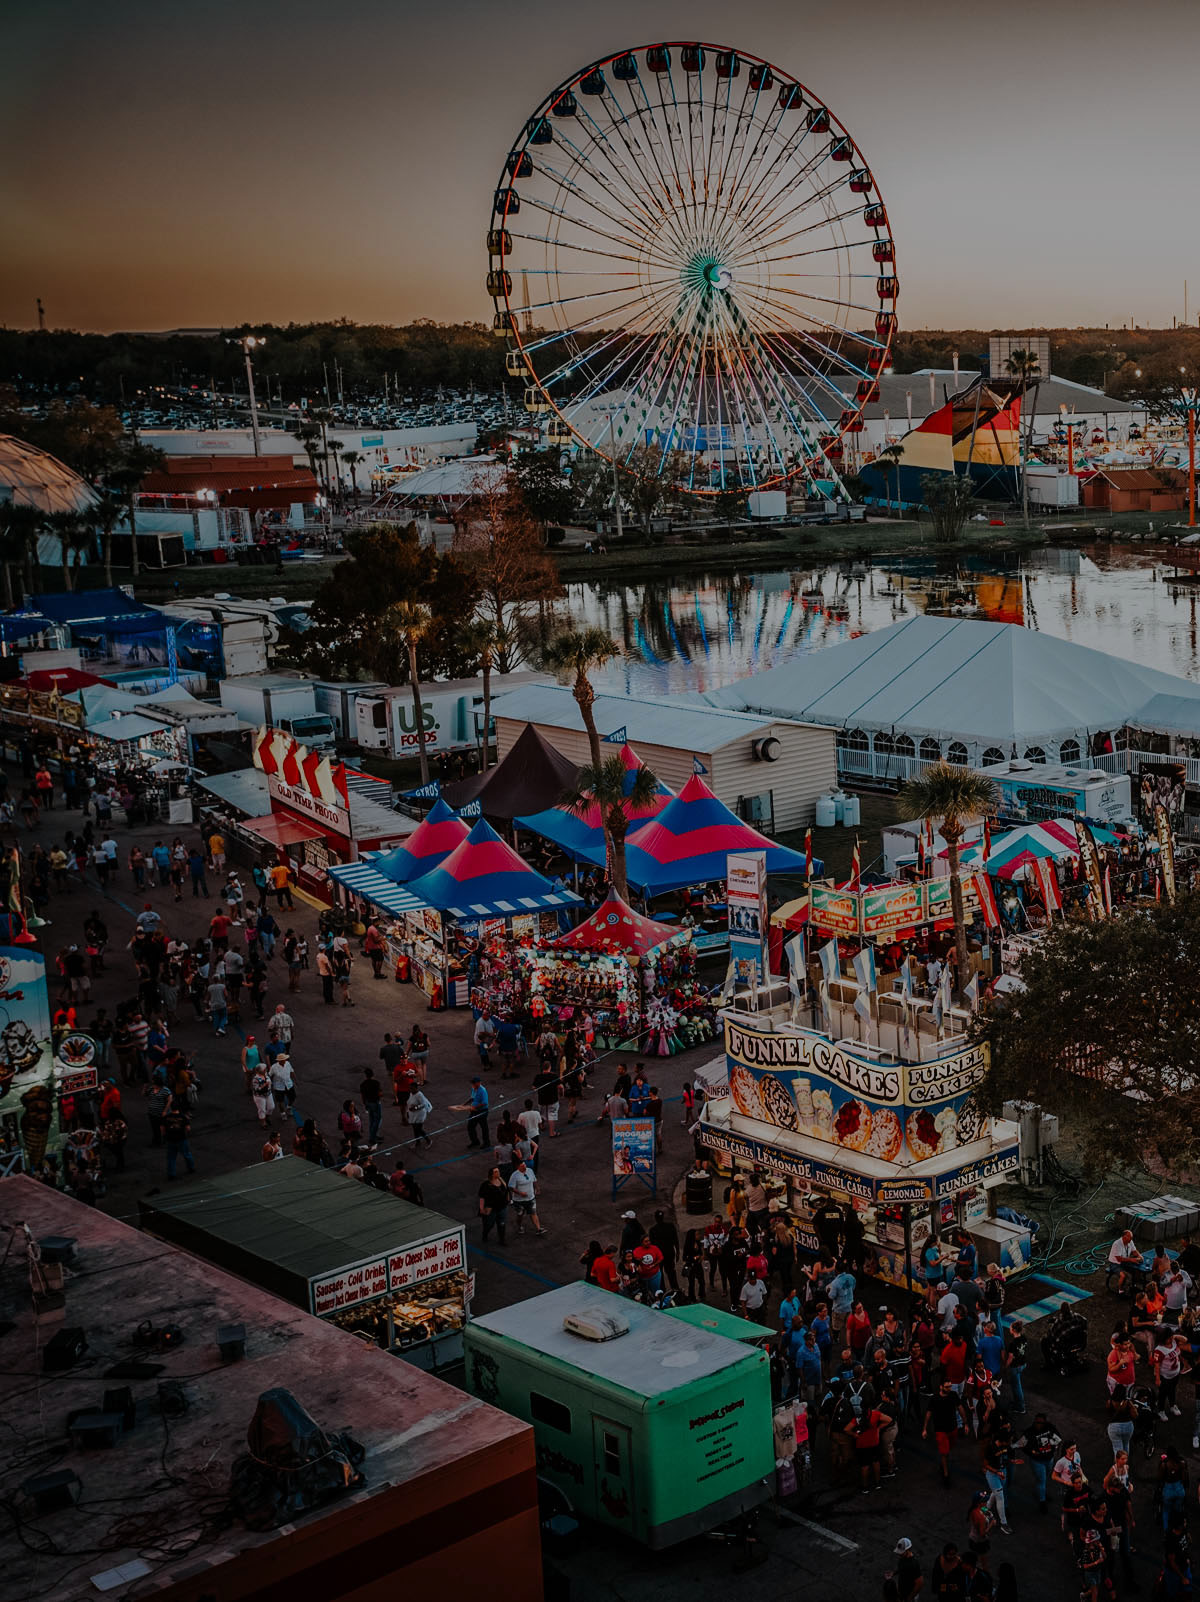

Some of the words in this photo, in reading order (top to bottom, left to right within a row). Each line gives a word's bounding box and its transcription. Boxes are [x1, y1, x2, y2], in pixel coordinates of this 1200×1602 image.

[278, 783, 292, 799] OLD
[293, 791, 312, 811] TYME
[314, 801, 339, 824] PHOTO
[415, 782, 438, 797] GYROS
[827, 899, 853, 914] CORN
[885, 893, 917, 911] CORN
[728, 1026, 812, 1068] FUNNEL
[811, 1042, 901, 1101] CAKES
[908, 1047, 986, 1086] FUNNEL
[908, 1064, 987, 1104] CAKES
[701, 1131, 730, 1152] FUNNEL
[730, 1141, 754, 1161] CAKES
[756, 1146, 813, 1179] LEMONADE
[938, 1169, 982, 1198] FUNNEL
[983, 1154, 1018, 1179] CAKES
[815, 1170, 846, 1191] FUNNEL
[846, 1179, 873, 1199] CAKES
[883, 1187, 926, 1201] LEMONADE
[405, 1250, 423, 1267] Cheese
[423, 1244, 438, 1260] Steak
[443, 1238, 459, 1255] Fries
[416, 1264, 429, 1279] Pork
[445, 1254, 461, 1269] Stick
[347, 1271, 363, 1287] Cold
[364, 1264, 386, 1280] Drinks
